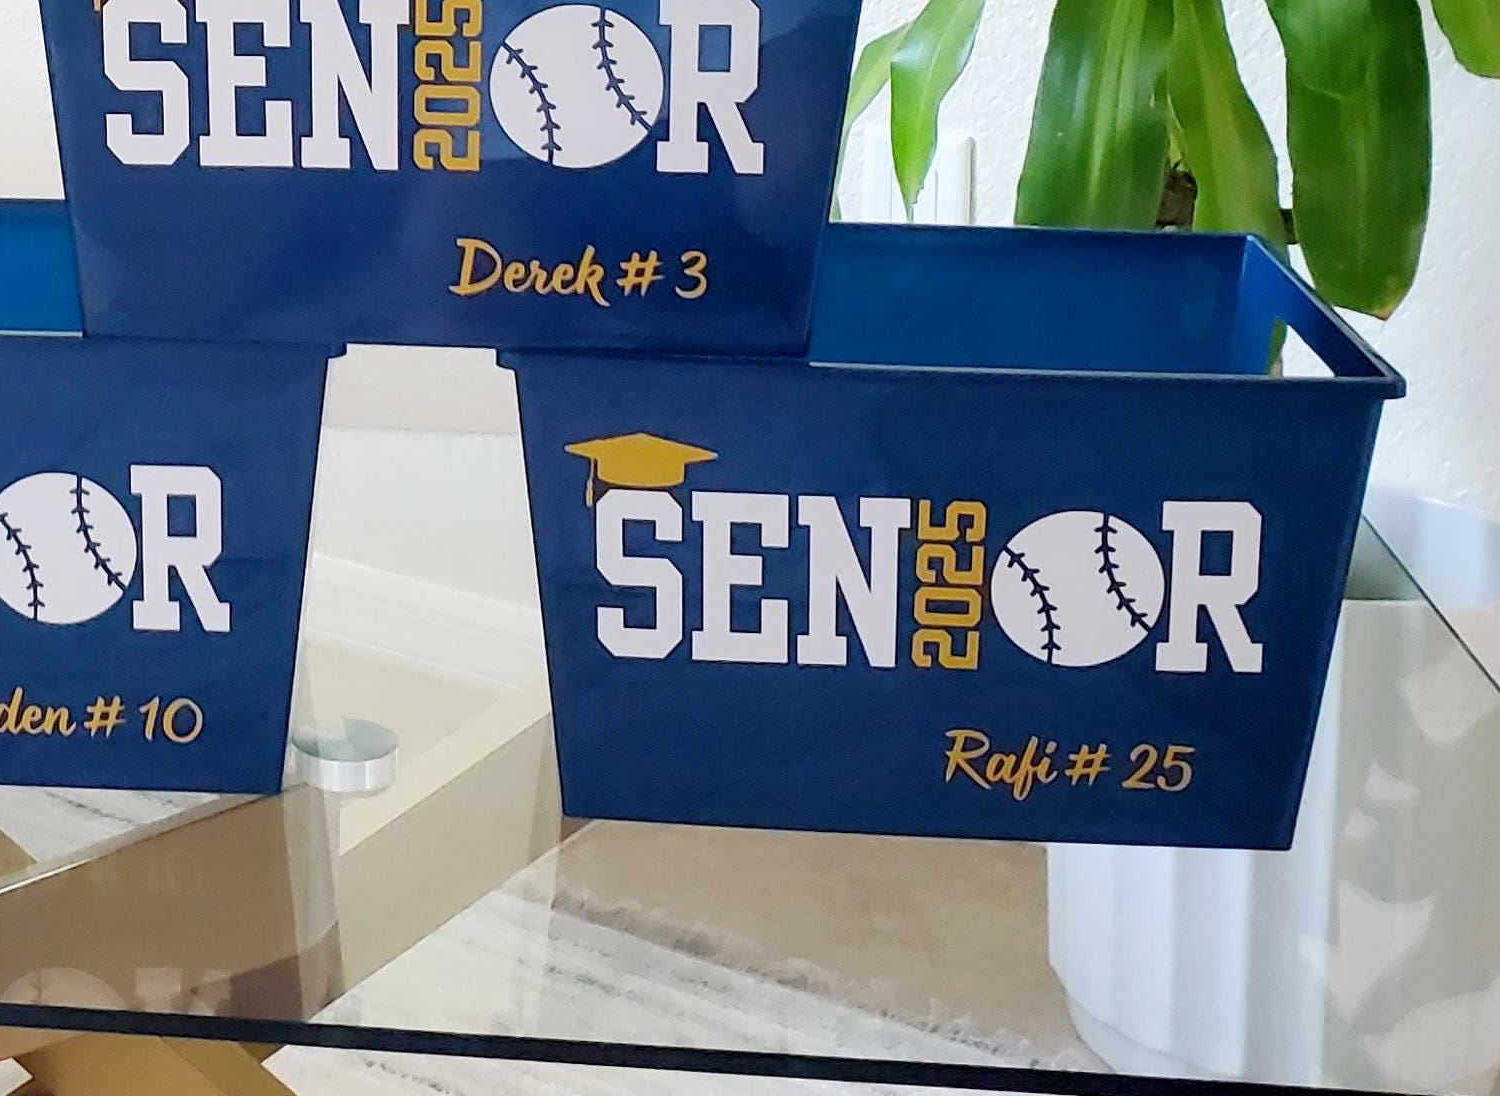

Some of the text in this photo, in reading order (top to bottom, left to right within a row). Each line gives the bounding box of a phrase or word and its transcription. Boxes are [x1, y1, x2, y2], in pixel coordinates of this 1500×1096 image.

[448, 237, 708, 307] Derek # 3
[911, 499, 987, 671] 2025
[84, 699, 125, 736] #
[138, 696, 204, 744] 10
[943, 729, 1194, 803] Rafi # 25
